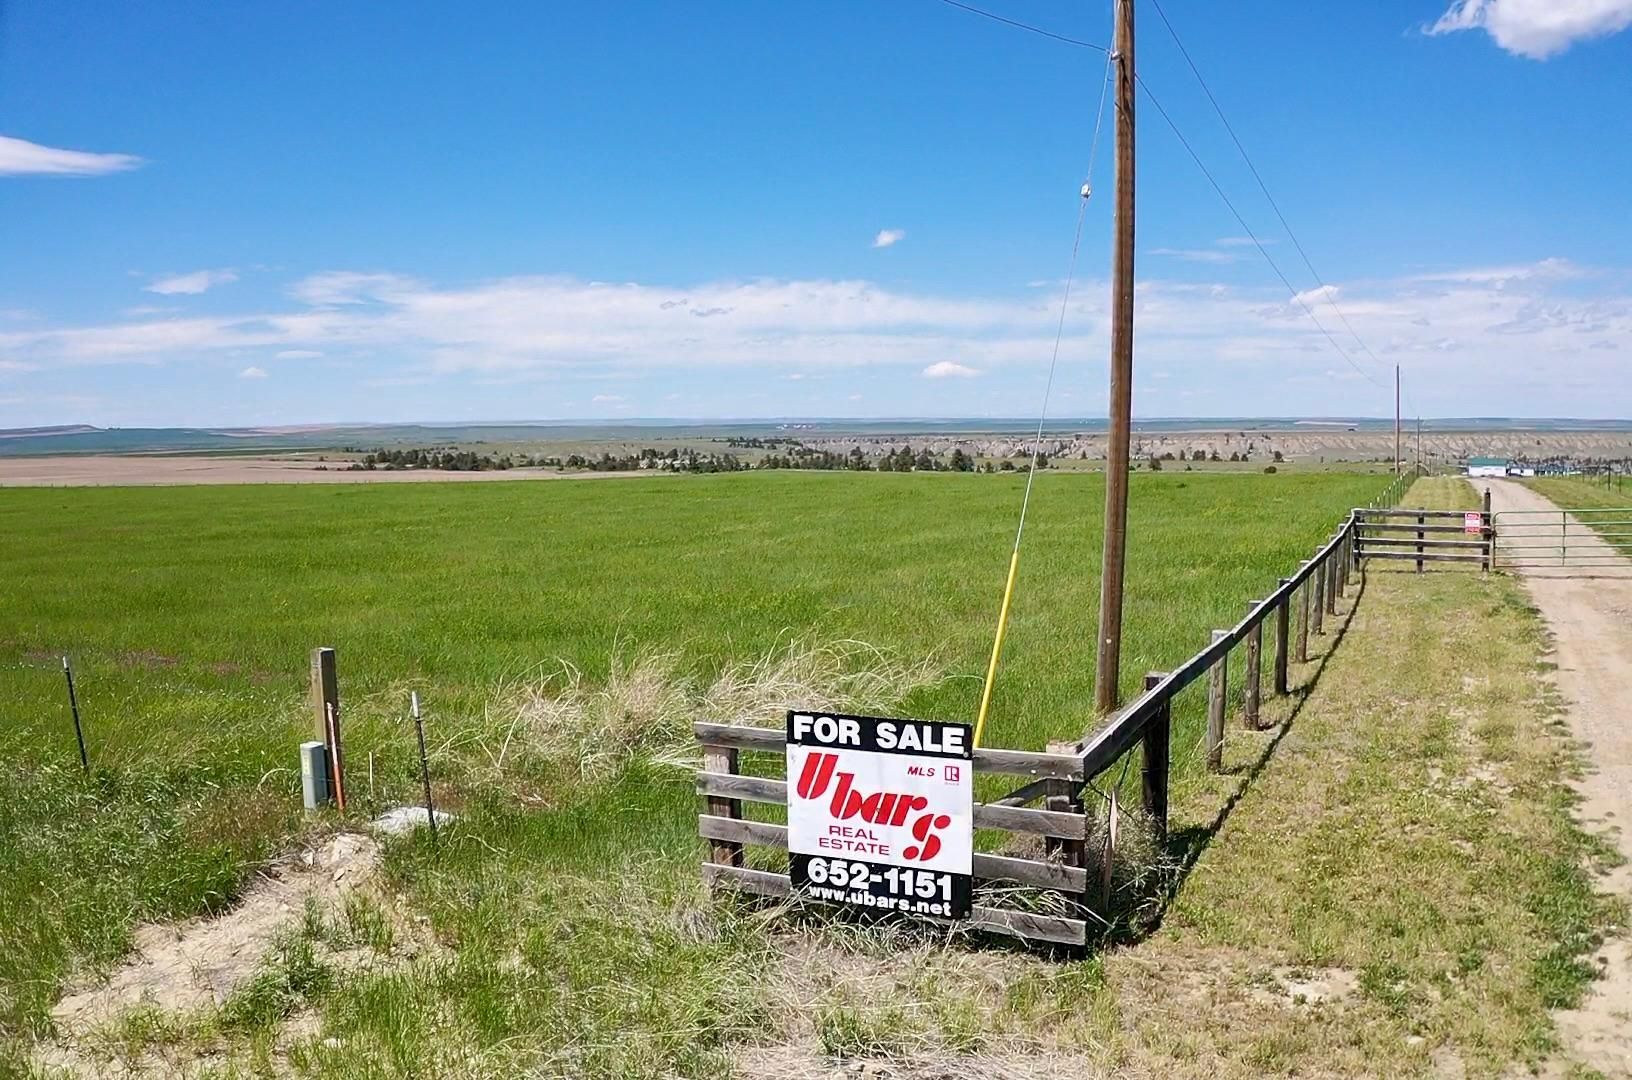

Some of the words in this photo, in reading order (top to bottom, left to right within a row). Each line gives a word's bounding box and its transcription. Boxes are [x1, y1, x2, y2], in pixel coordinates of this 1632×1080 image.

[793, 715, 861, 745] FOR
[875, 722, 965, 754] SALE
[907, 766, 935, 777] MLS
[829, 825, 879, 841] REAL
[819, 837, 890, 856] ESTATE
[807, 857, 952, 901] 652-1151
[809, 886, 951, 917] www.ubars.net
